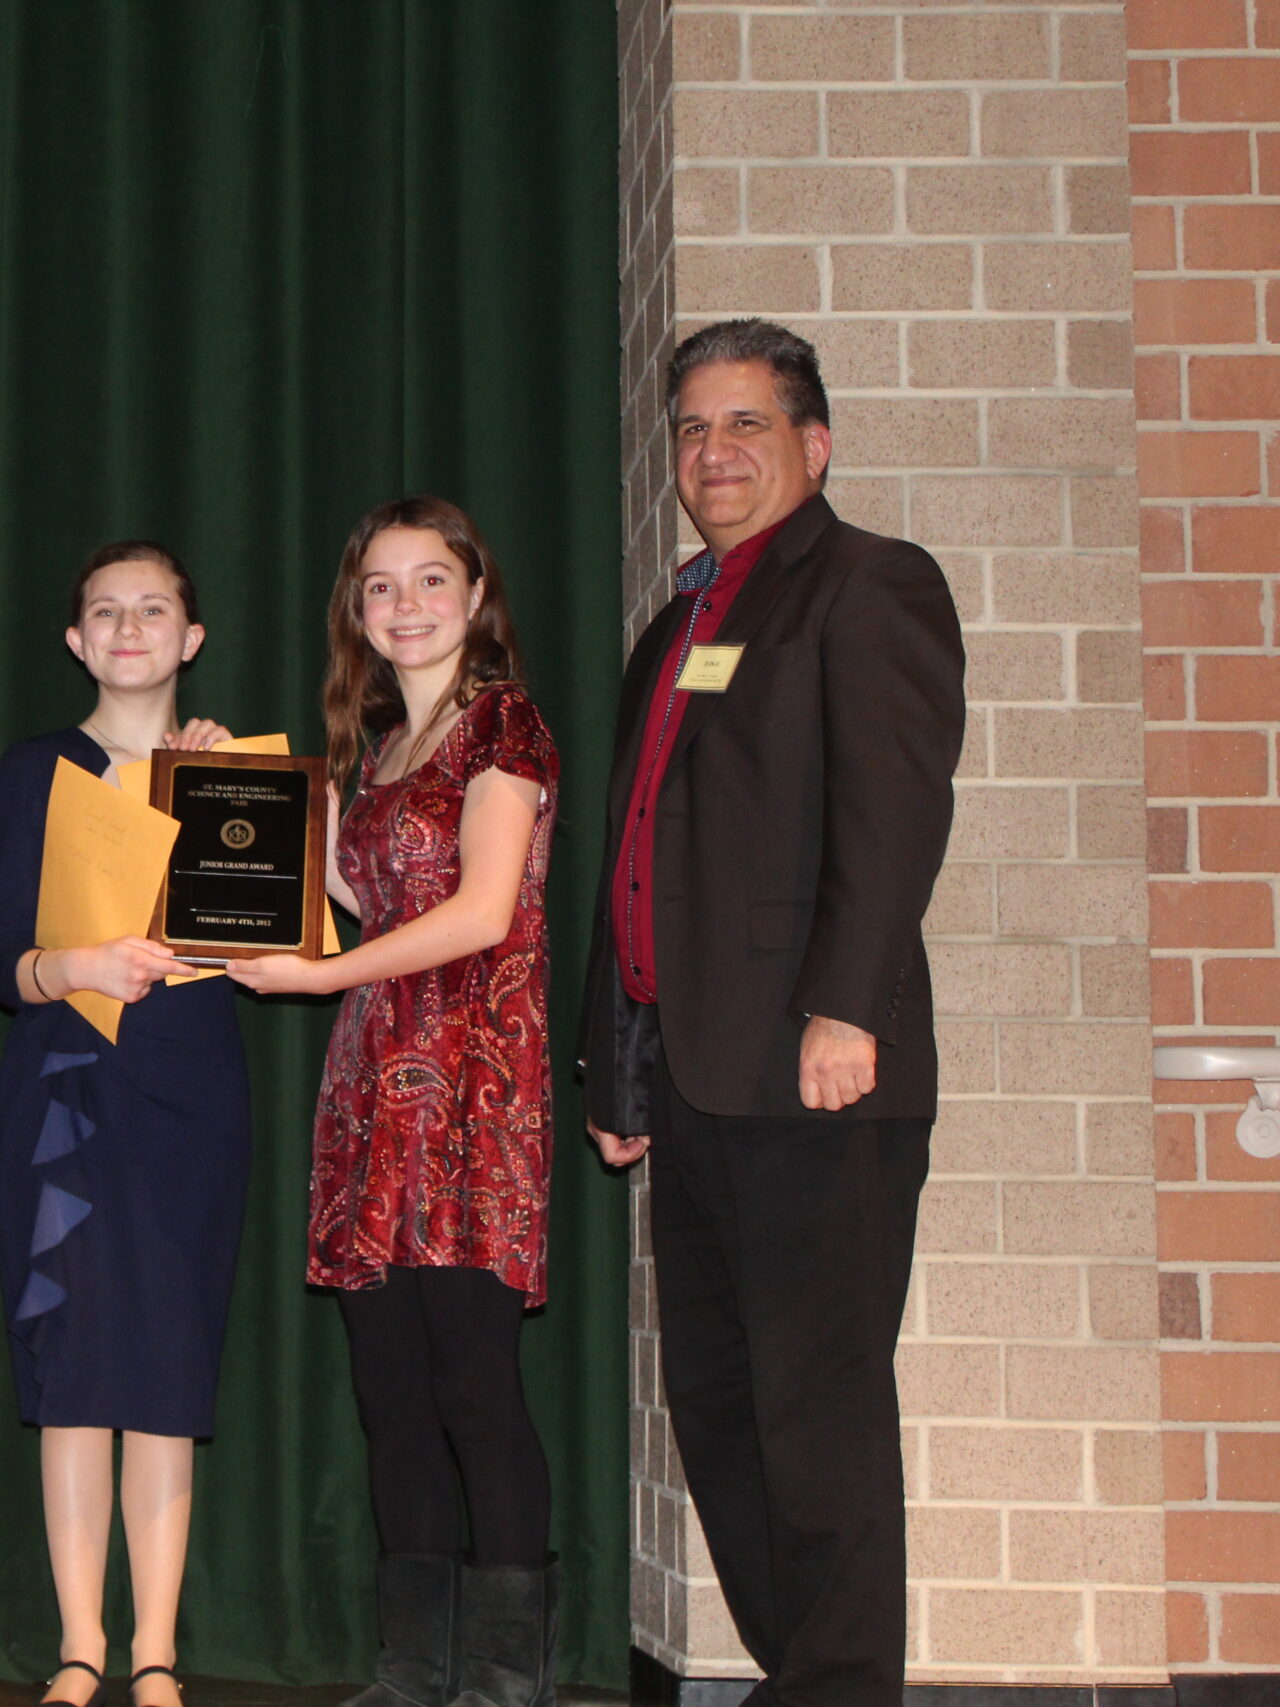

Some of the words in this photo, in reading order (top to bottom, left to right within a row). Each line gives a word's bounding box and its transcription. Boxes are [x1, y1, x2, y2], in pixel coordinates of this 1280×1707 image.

[215, 784, 244, 792] MARY'S
[245, 786, 278, 794] COUNTY
[187, 790, 221, 798] SCIENCE
[221, 791, 238, 799] AND
[238, 792, 292, 802] ENGINEERING
[230, 799, 248, 807] FAIR
[199, 860, 223, 869] JUNIOR
[224, 861, 249, 870] GRAND
[249, 863, 274, 871] AWARD
[196, 916, 238, 925] FEBRUARY
